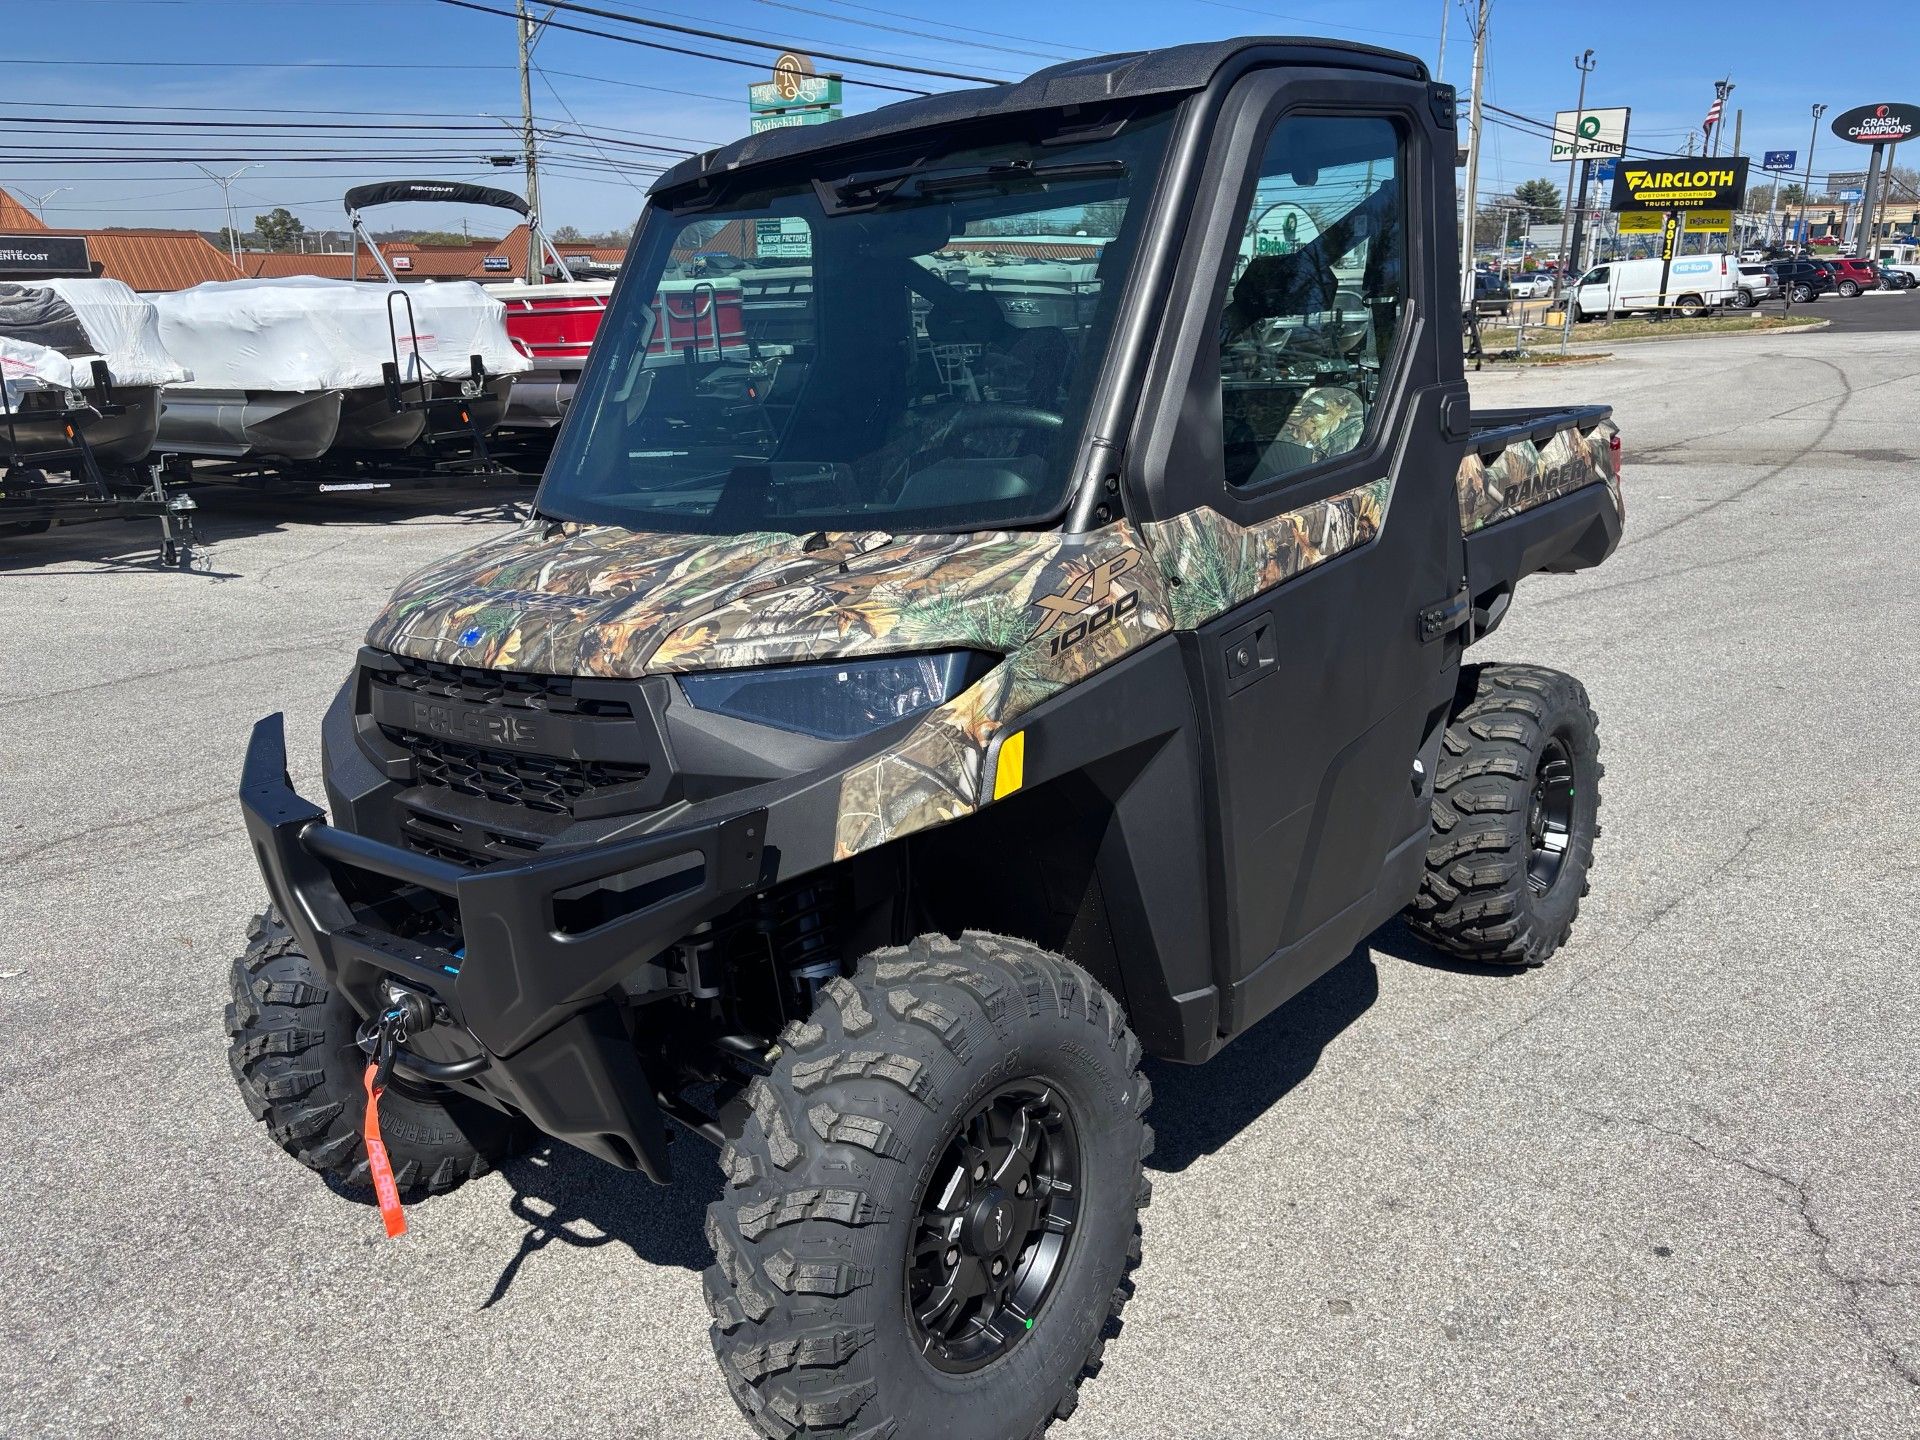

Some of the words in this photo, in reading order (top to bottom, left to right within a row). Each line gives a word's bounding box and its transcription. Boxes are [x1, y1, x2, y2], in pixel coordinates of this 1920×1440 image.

[1848, 125, 1912, 136] CHAMPIONS
[1862, 117, 1900, 127] CRASH
[1553, 143, 1621, 155] DriveTime
[1625, 170, 1734, 191] FAIRCLOTH
[1663, 219, 1676, 260] 8812
[1501, 459, 1588, 511] RANGER
[1024, 547, 1142, 645] XP
[1050, 589, 1139, 658] 1000
[412, 700, 538, 749] POLARIS
[369, 1139, 399, 1211] POLARIS
